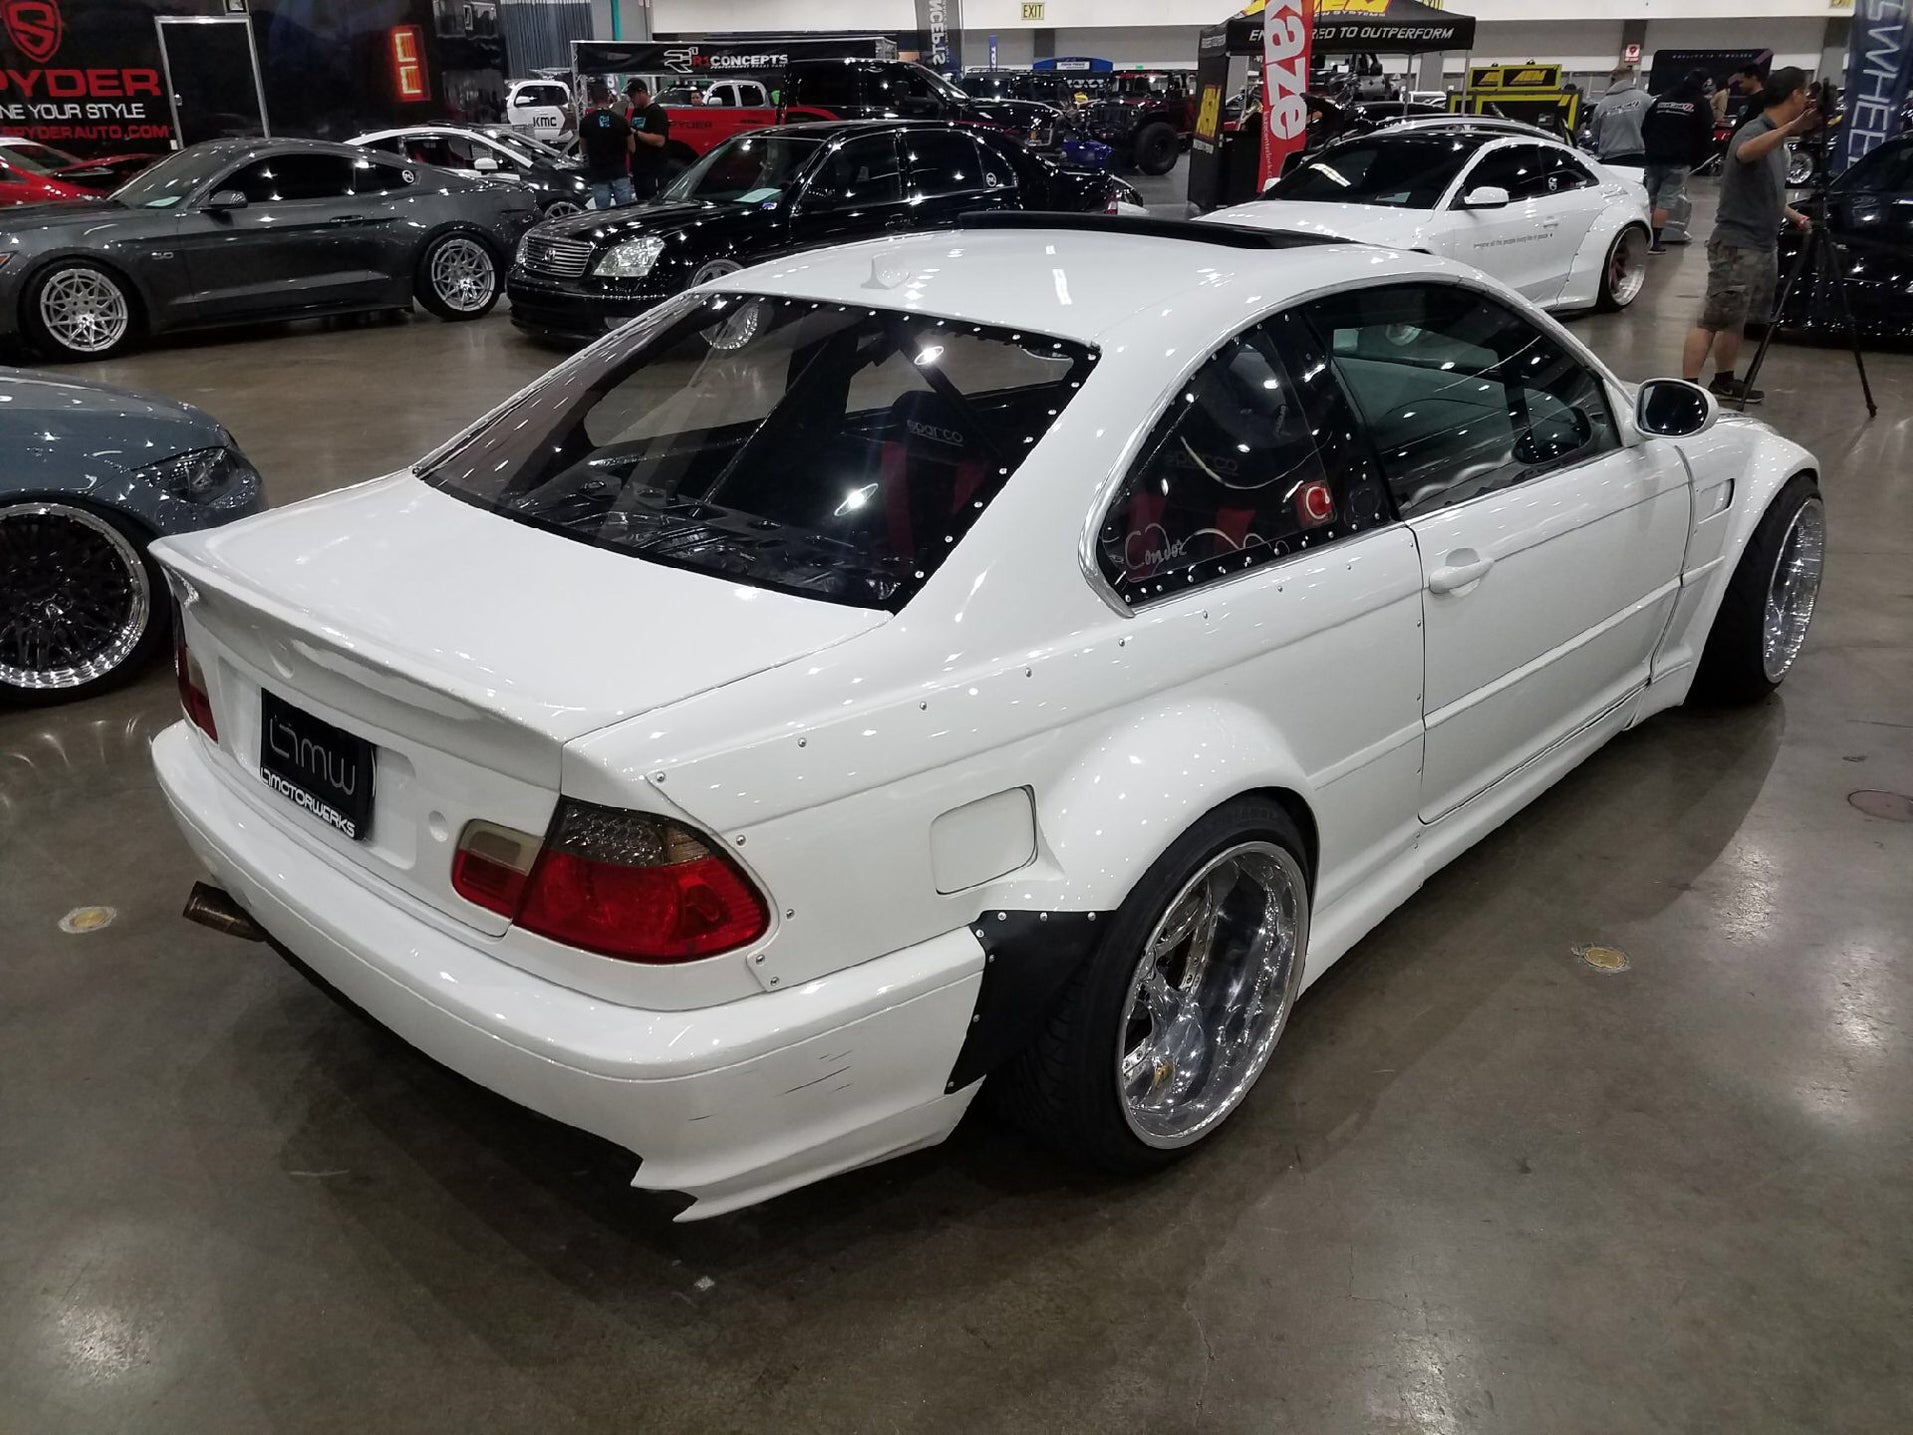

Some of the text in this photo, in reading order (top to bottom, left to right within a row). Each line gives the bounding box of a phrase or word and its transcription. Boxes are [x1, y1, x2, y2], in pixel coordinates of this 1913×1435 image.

[1023, 4, 1042, 18] EXIT
[1340, 27, 1359, 38] TO
[1360, 27, 1455, 40] OUTPERFORM
[710, 54, 788, 67] CONCEPTS
[0, 69, 161, 97] YDER
[28, 104, 82, 119] YOUR
[85, 103, 146, 118] STYLE
[532, 115, 557, 128] KMC
[906, 419, 964, 443] sparco
